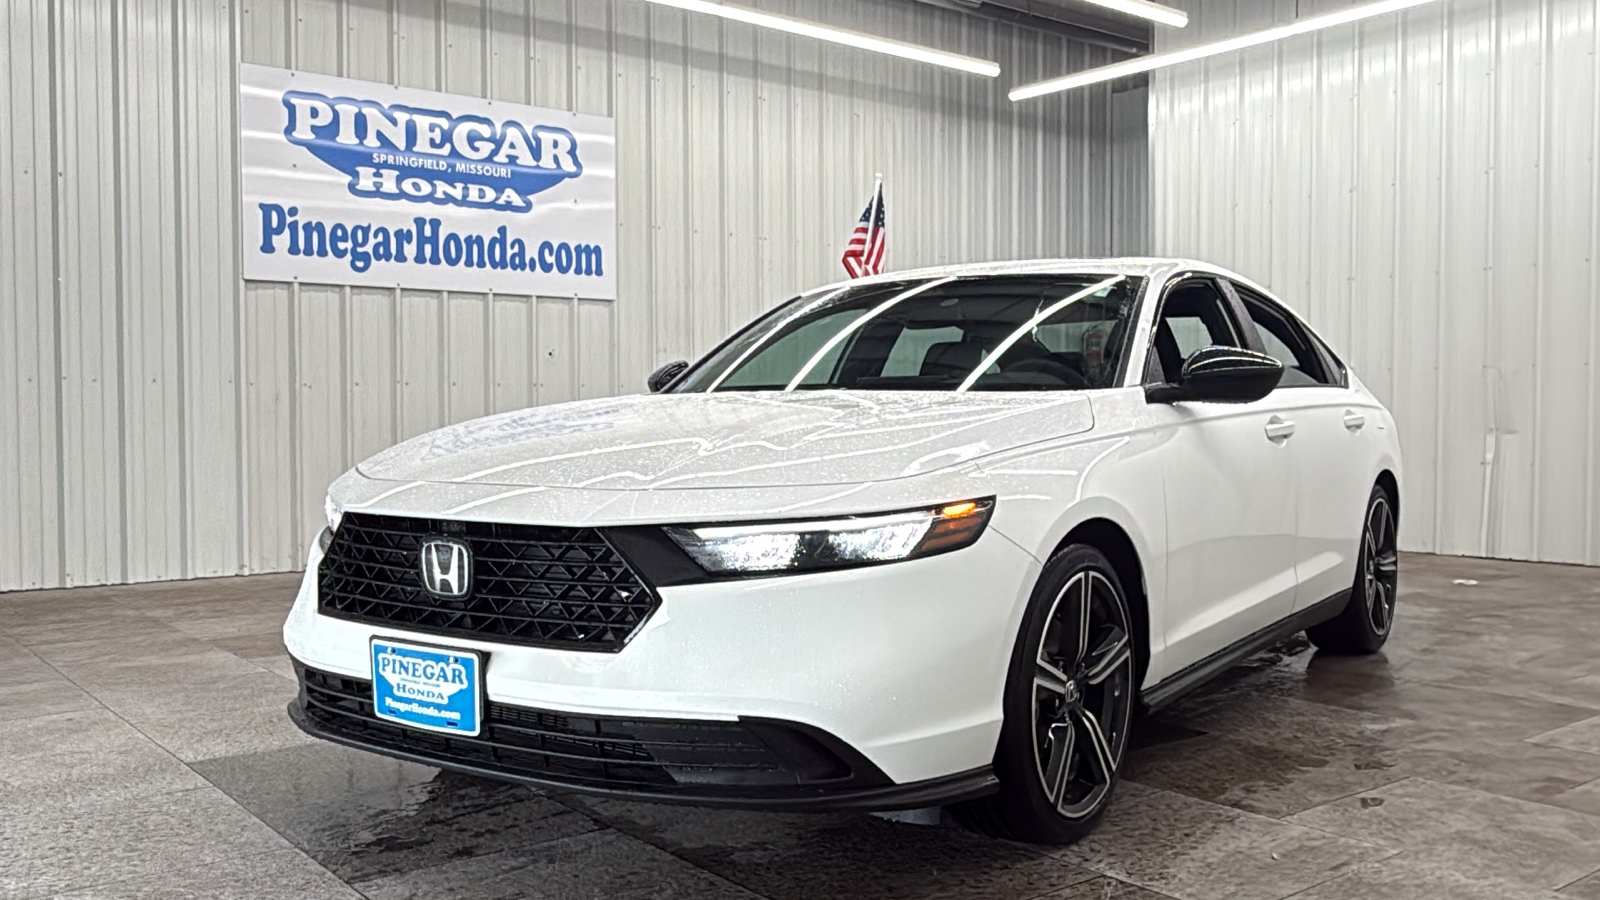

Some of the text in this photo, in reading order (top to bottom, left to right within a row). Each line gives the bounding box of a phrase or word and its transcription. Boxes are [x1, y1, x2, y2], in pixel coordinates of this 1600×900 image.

[288, 97, 578, 173] PINEGAR
[372, 152, 512, 179] SPRINGFIELD, MISSOURI
[354, 166, 527, 207] HONDA
[258, 202, 604, 277] PinegarHonda.com
[381, 657, 465, 685] PINEGAR
[396, 682, 445, 700] HONDA
